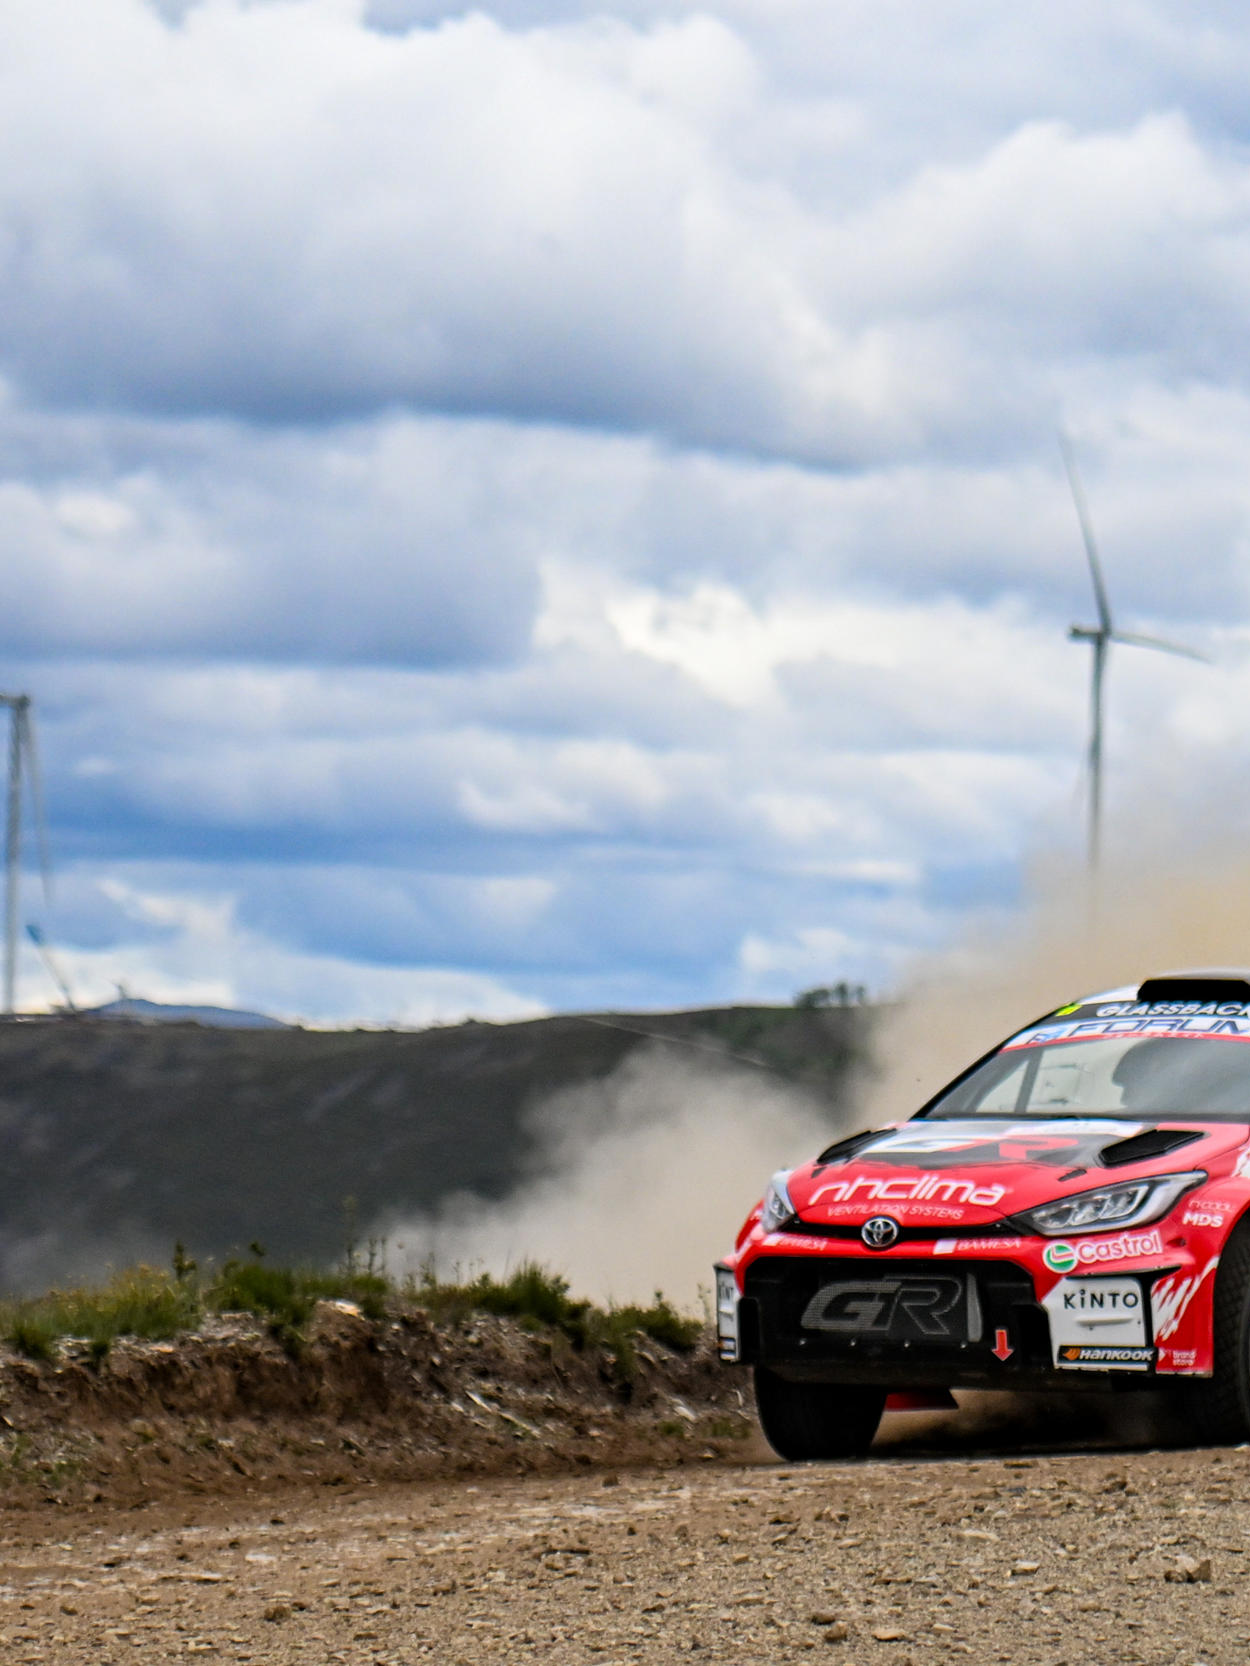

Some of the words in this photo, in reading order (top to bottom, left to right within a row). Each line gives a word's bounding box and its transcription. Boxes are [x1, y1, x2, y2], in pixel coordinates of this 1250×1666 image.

[827, 1203, 906, 1218] VENTILATION
[909, 1205, 965, 1220] SYSTEMS
[1182, 1212, 1223, 1228] MDS
[1078, 1231, 1163, 1265] Castrol
[801, 1272, 962, 1336] GR
